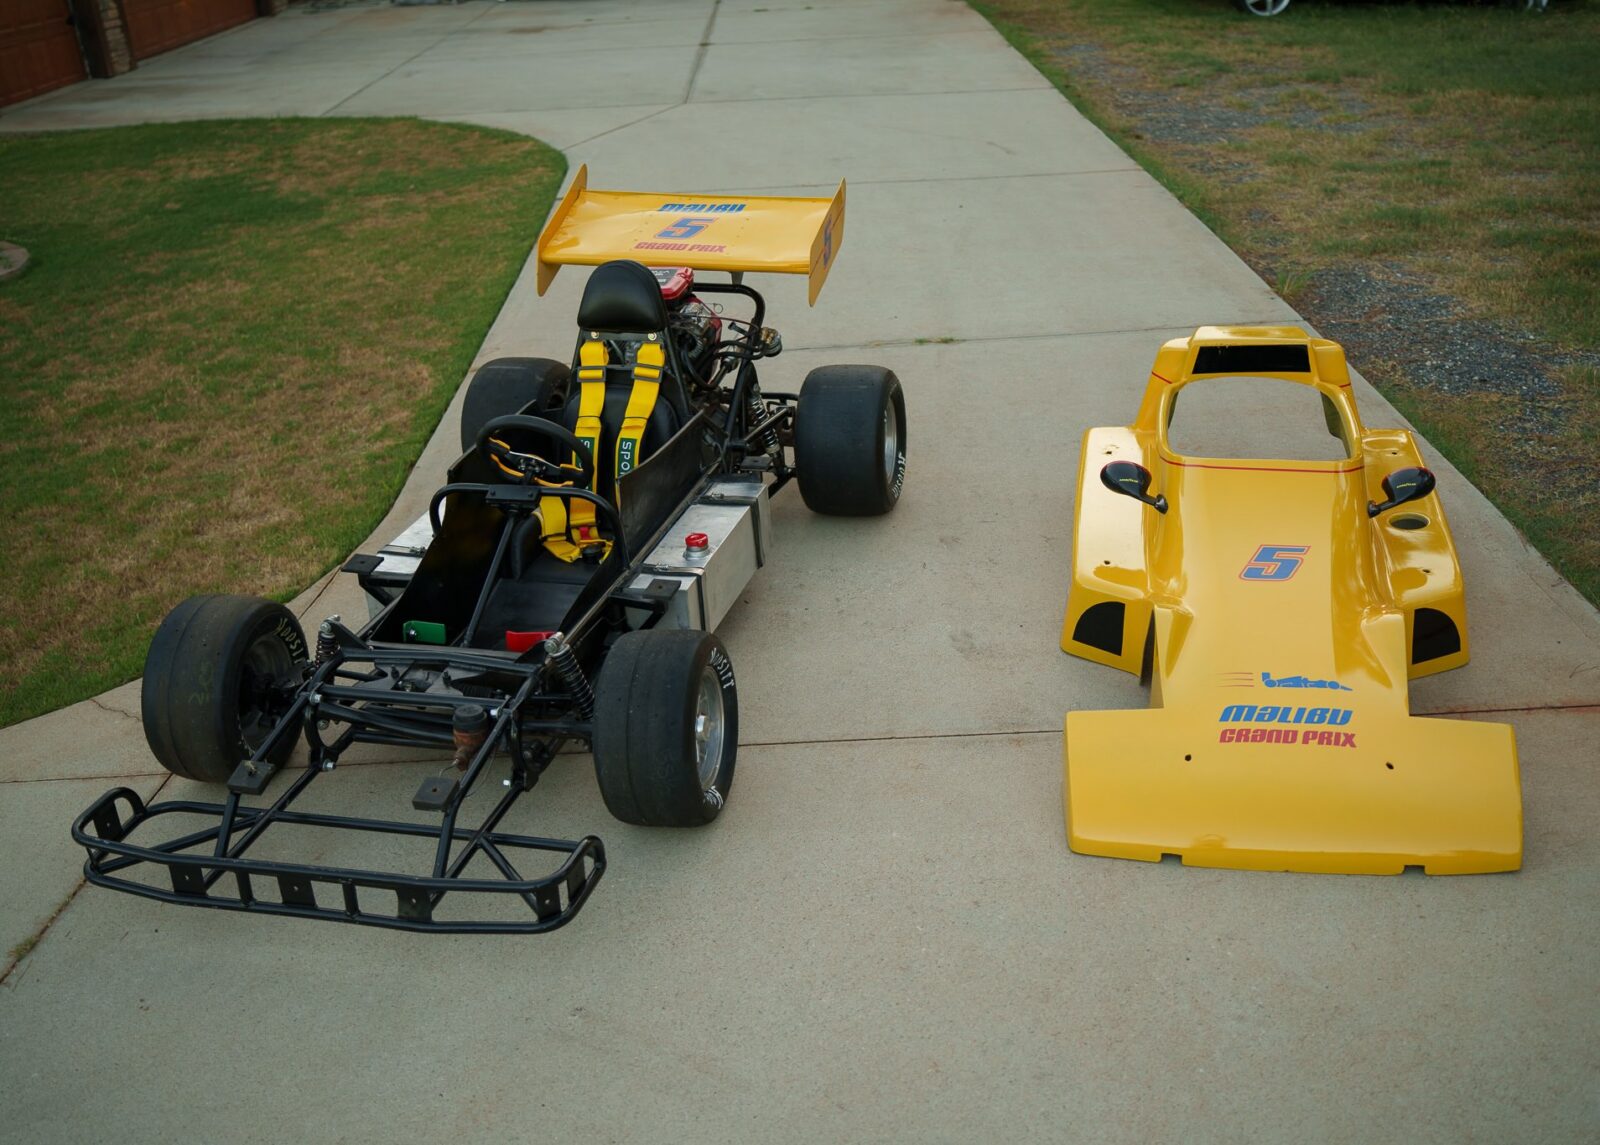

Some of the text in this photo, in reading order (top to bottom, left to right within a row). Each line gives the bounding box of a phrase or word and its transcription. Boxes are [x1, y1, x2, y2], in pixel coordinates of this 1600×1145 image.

[653, 216, 719, 240] 5
[634, 241, 727, 253] GRAND PRIX
[620, 441, 633, 475] SPO
[1238, 544, 1312, 582] 5
[1218, 704, 1354, 726] MALIBU
[1219, 728, 1357, 748] GRAND PRIX
